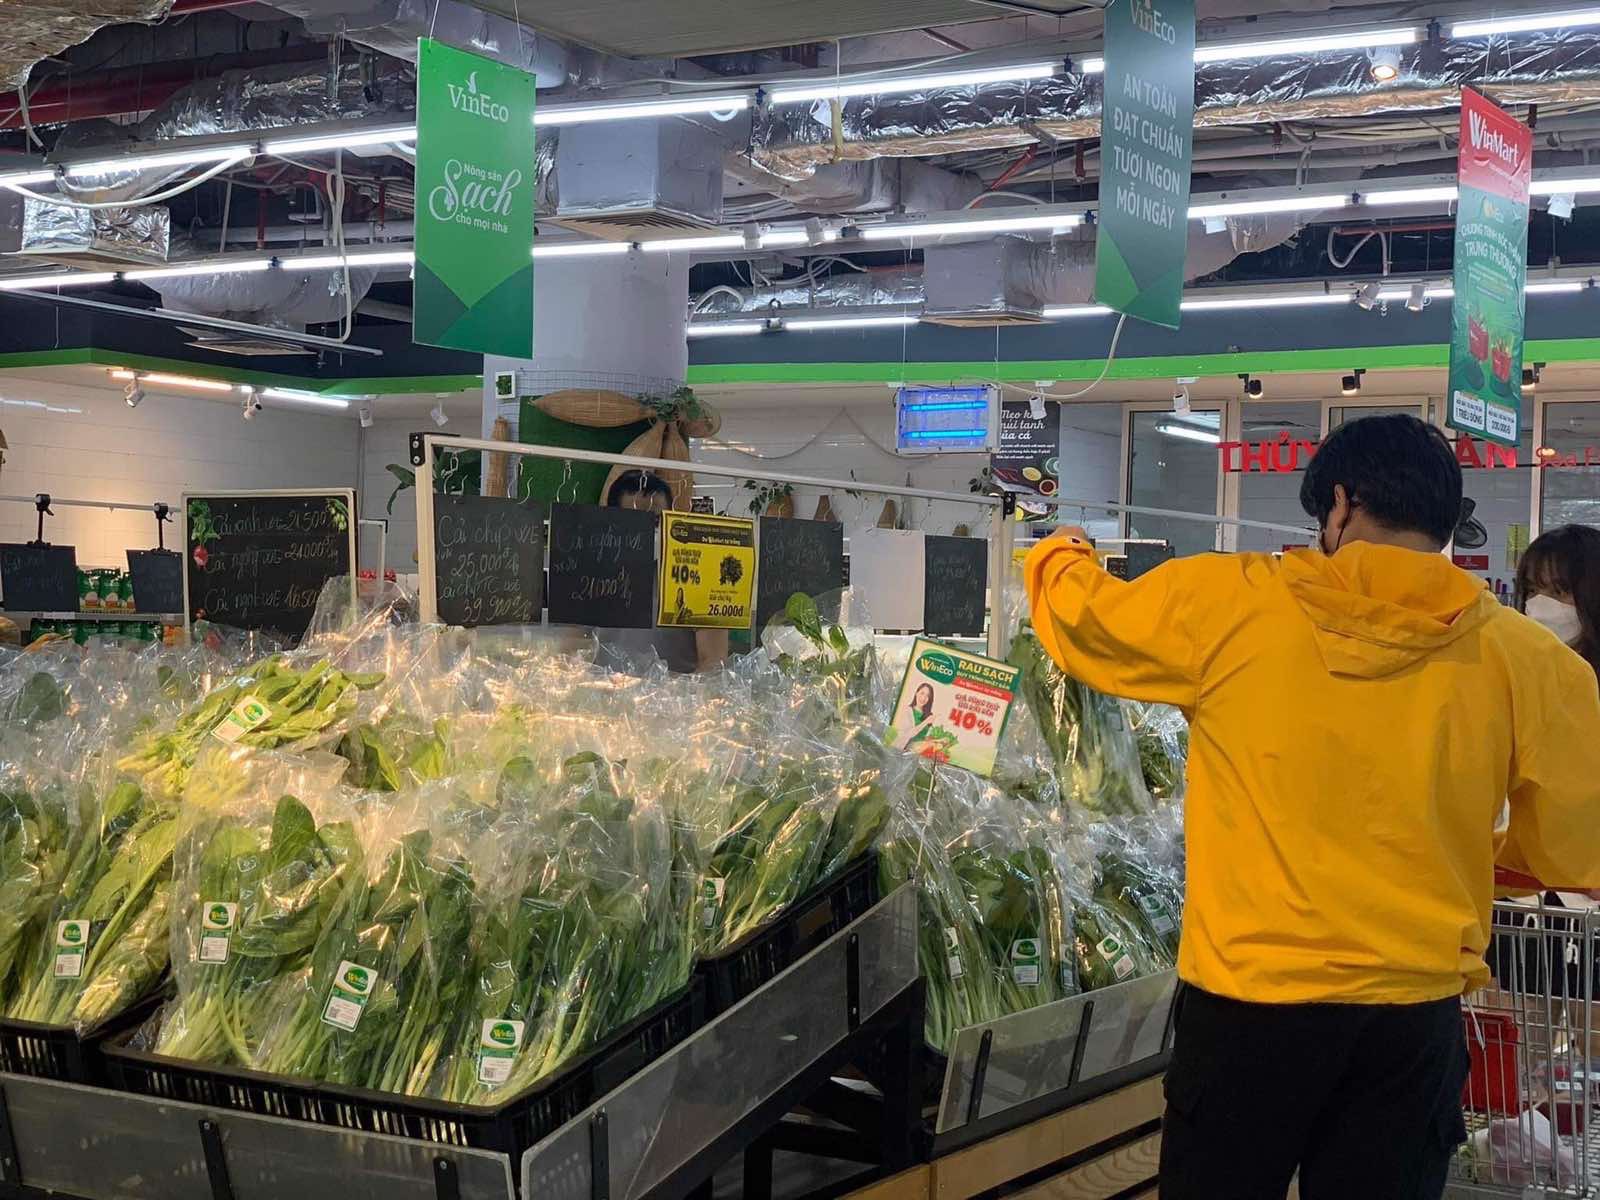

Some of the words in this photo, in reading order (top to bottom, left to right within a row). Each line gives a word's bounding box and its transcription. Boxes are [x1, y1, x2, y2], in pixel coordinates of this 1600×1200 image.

[1129, 0, 1176, 45] VinEco
[447, 82, 510, 123] VinEco
[1123, 73, 1142, 101] AN
[1145, 80, 1177, 118] TOÀN
[1113, 107, 1139, 141] ĐẠT
[1141, 122, 1183, 160] CHUẨN
[1468, 108, 1520, 167] WinMart
[429, 159, 522, 221] Sạch
[463, 163, 486, 181] Nông
[1113, 146, 1144, 179] TƯƠI
[1145, 163, 1181, 196] NGON
[456, 212, 472, 225] cho
[473, 218, 490, 231] mọi
[1116, 182, 1141, 218] MỖI
[1143, 195, 1176, 231] NGÀY
[671, 565, 701, 586] 40%
[707, 604, 744, 617] 26.000đ
[920, 657, 954, 677] WinEco
[958, 660, 982, 674] RAU
[983, 667, 1014, 683] SẠCH
[949, 707, 993, 736] 40%
